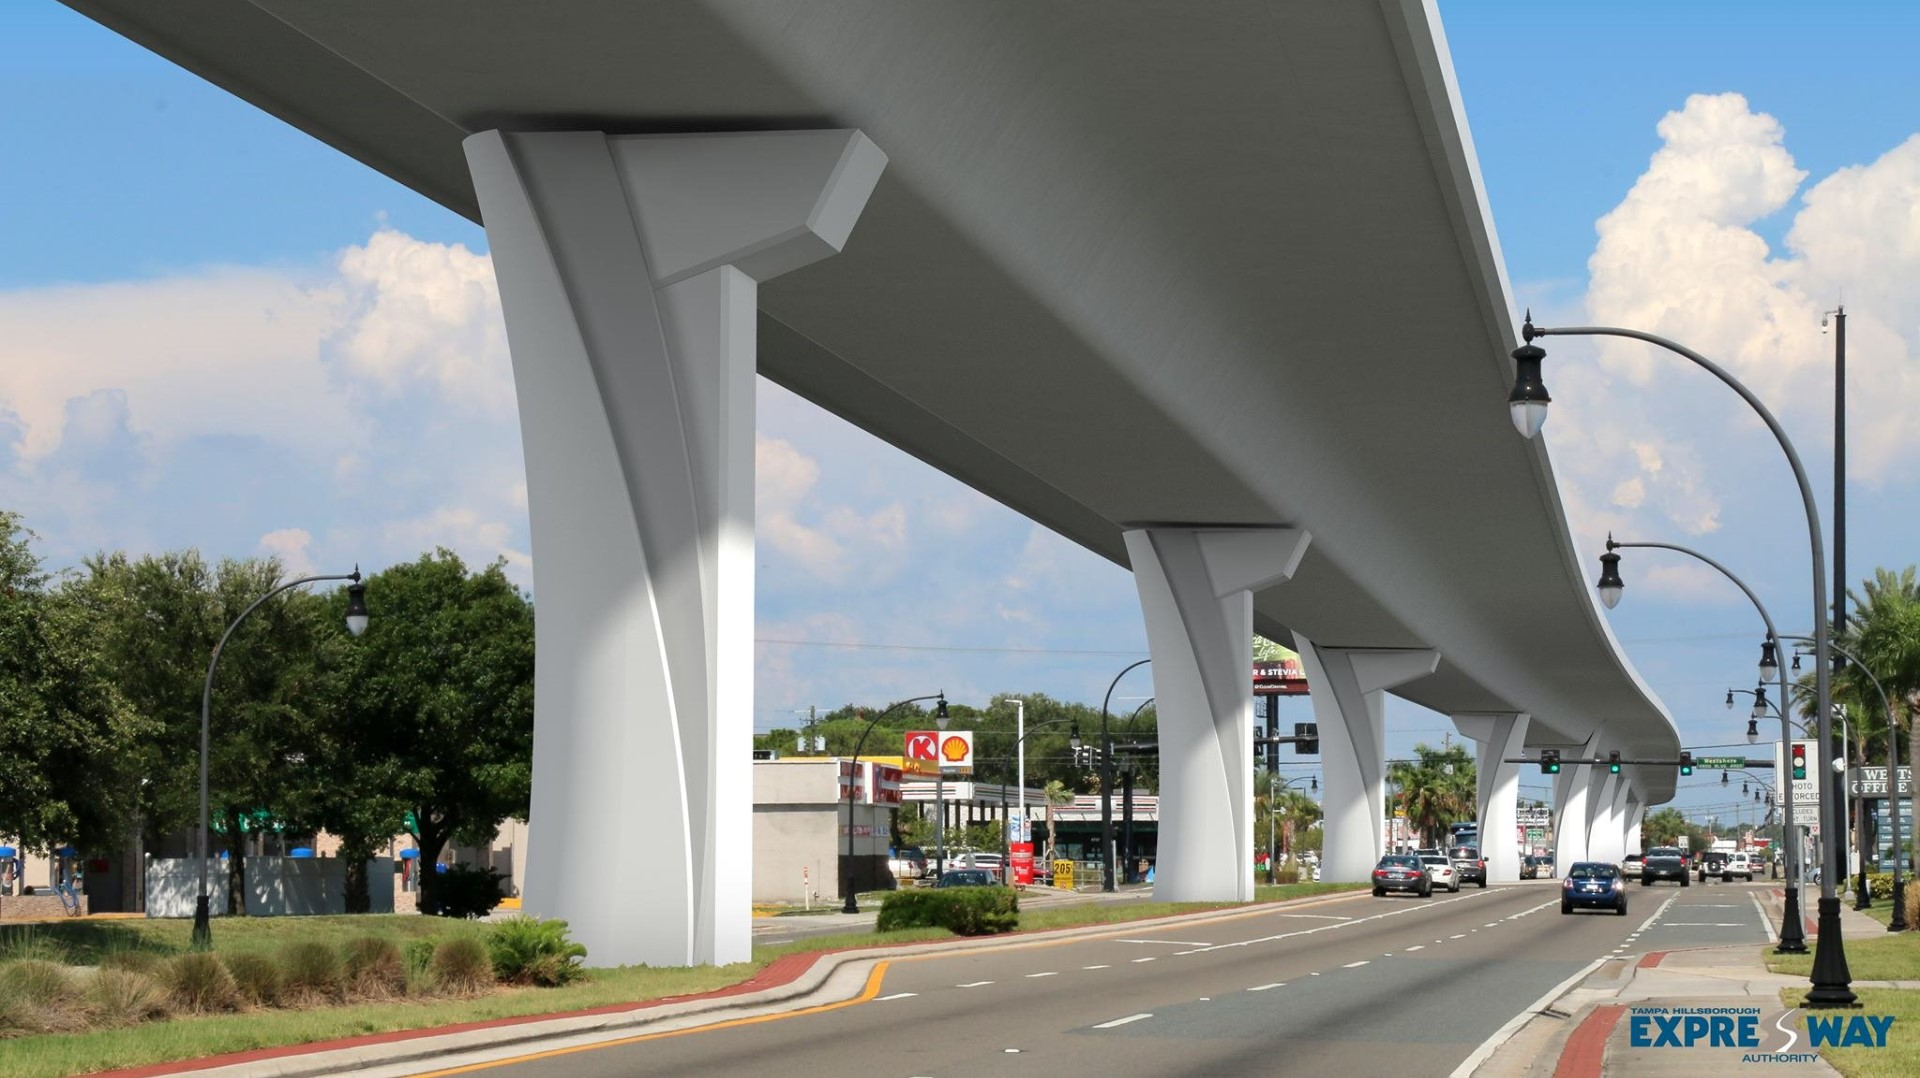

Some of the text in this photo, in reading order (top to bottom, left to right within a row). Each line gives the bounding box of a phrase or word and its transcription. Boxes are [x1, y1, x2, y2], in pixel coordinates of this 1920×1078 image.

[1851, 782, 1908, 794] OFFIE
[1778, 792, 1820, 800] EORCED
[1054, 863, 1071, 874] 205
